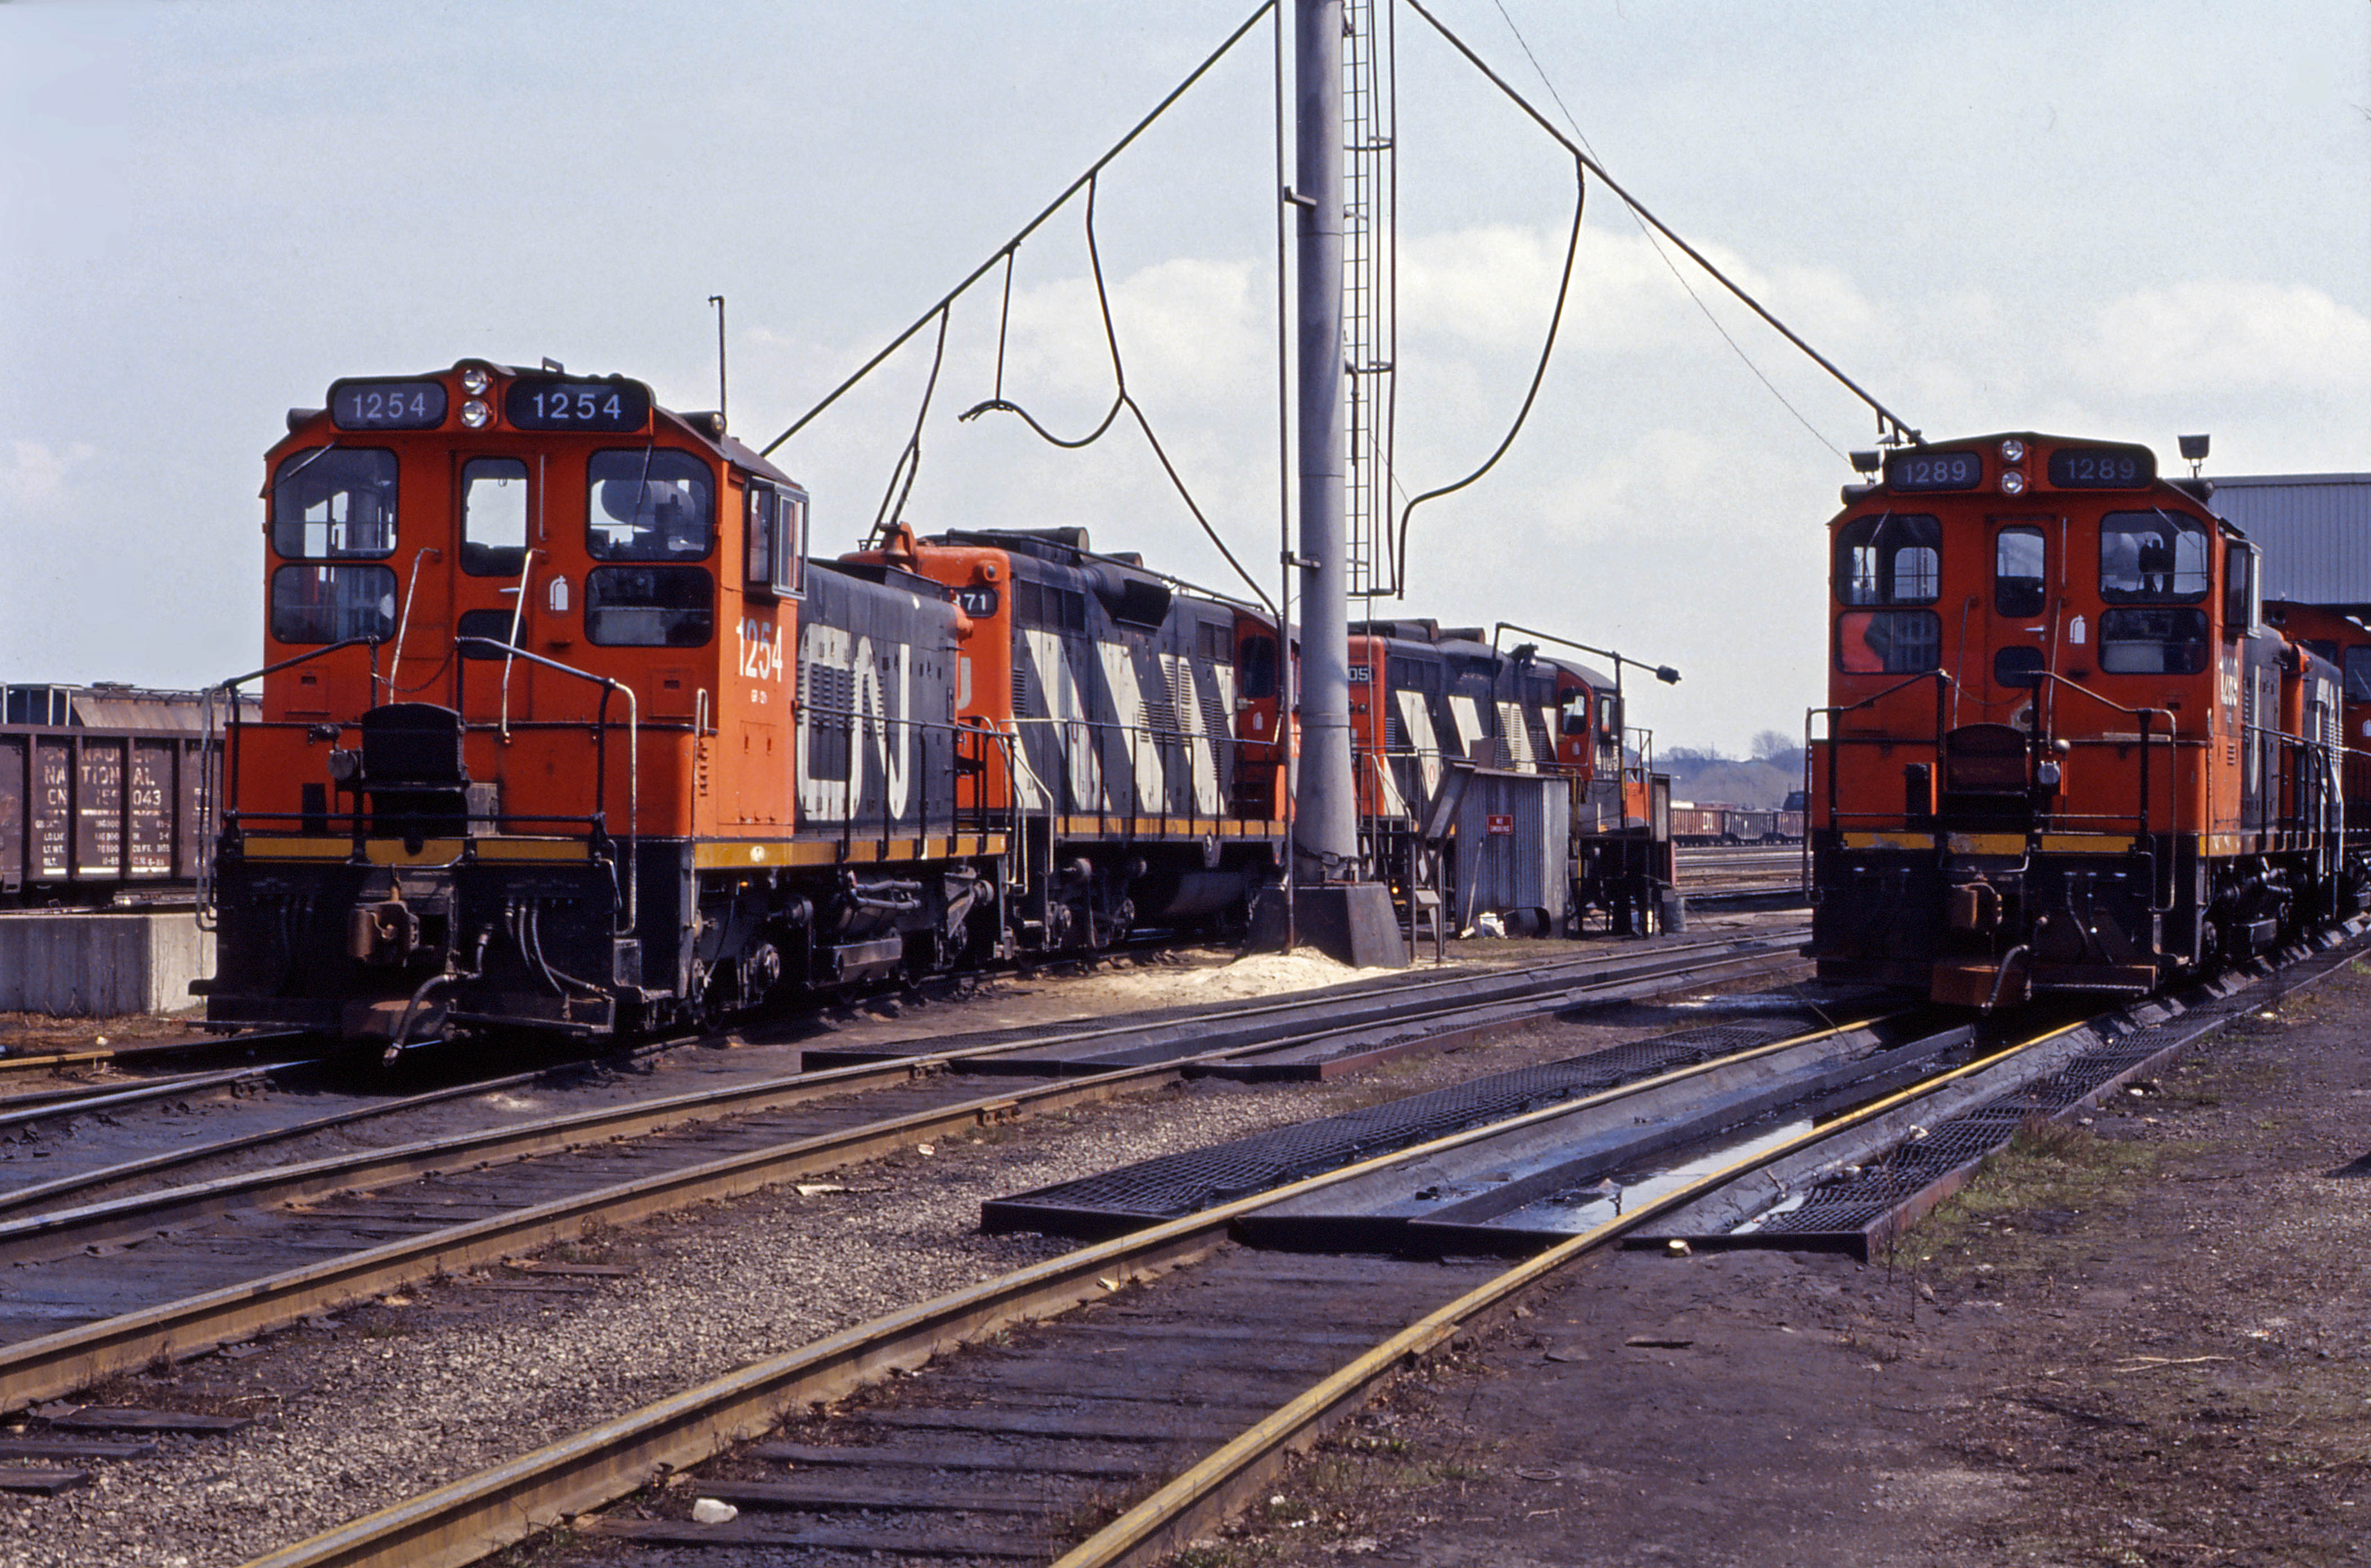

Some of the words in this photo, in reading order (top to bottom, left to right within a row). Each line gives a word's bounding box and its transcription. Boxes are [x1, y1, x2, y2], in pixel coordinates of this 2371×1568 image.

[352, 392, 426, 418] 1254
[532, 393, 621, 420] 1254
[1904, 461, 1967, 483] 1289
[2067, 457, 2135, 481] 1289
[735, 617, 782, 682] 1254
[1349, 667, 1369, 682] 05
[47, 789, 67, 805] CN
